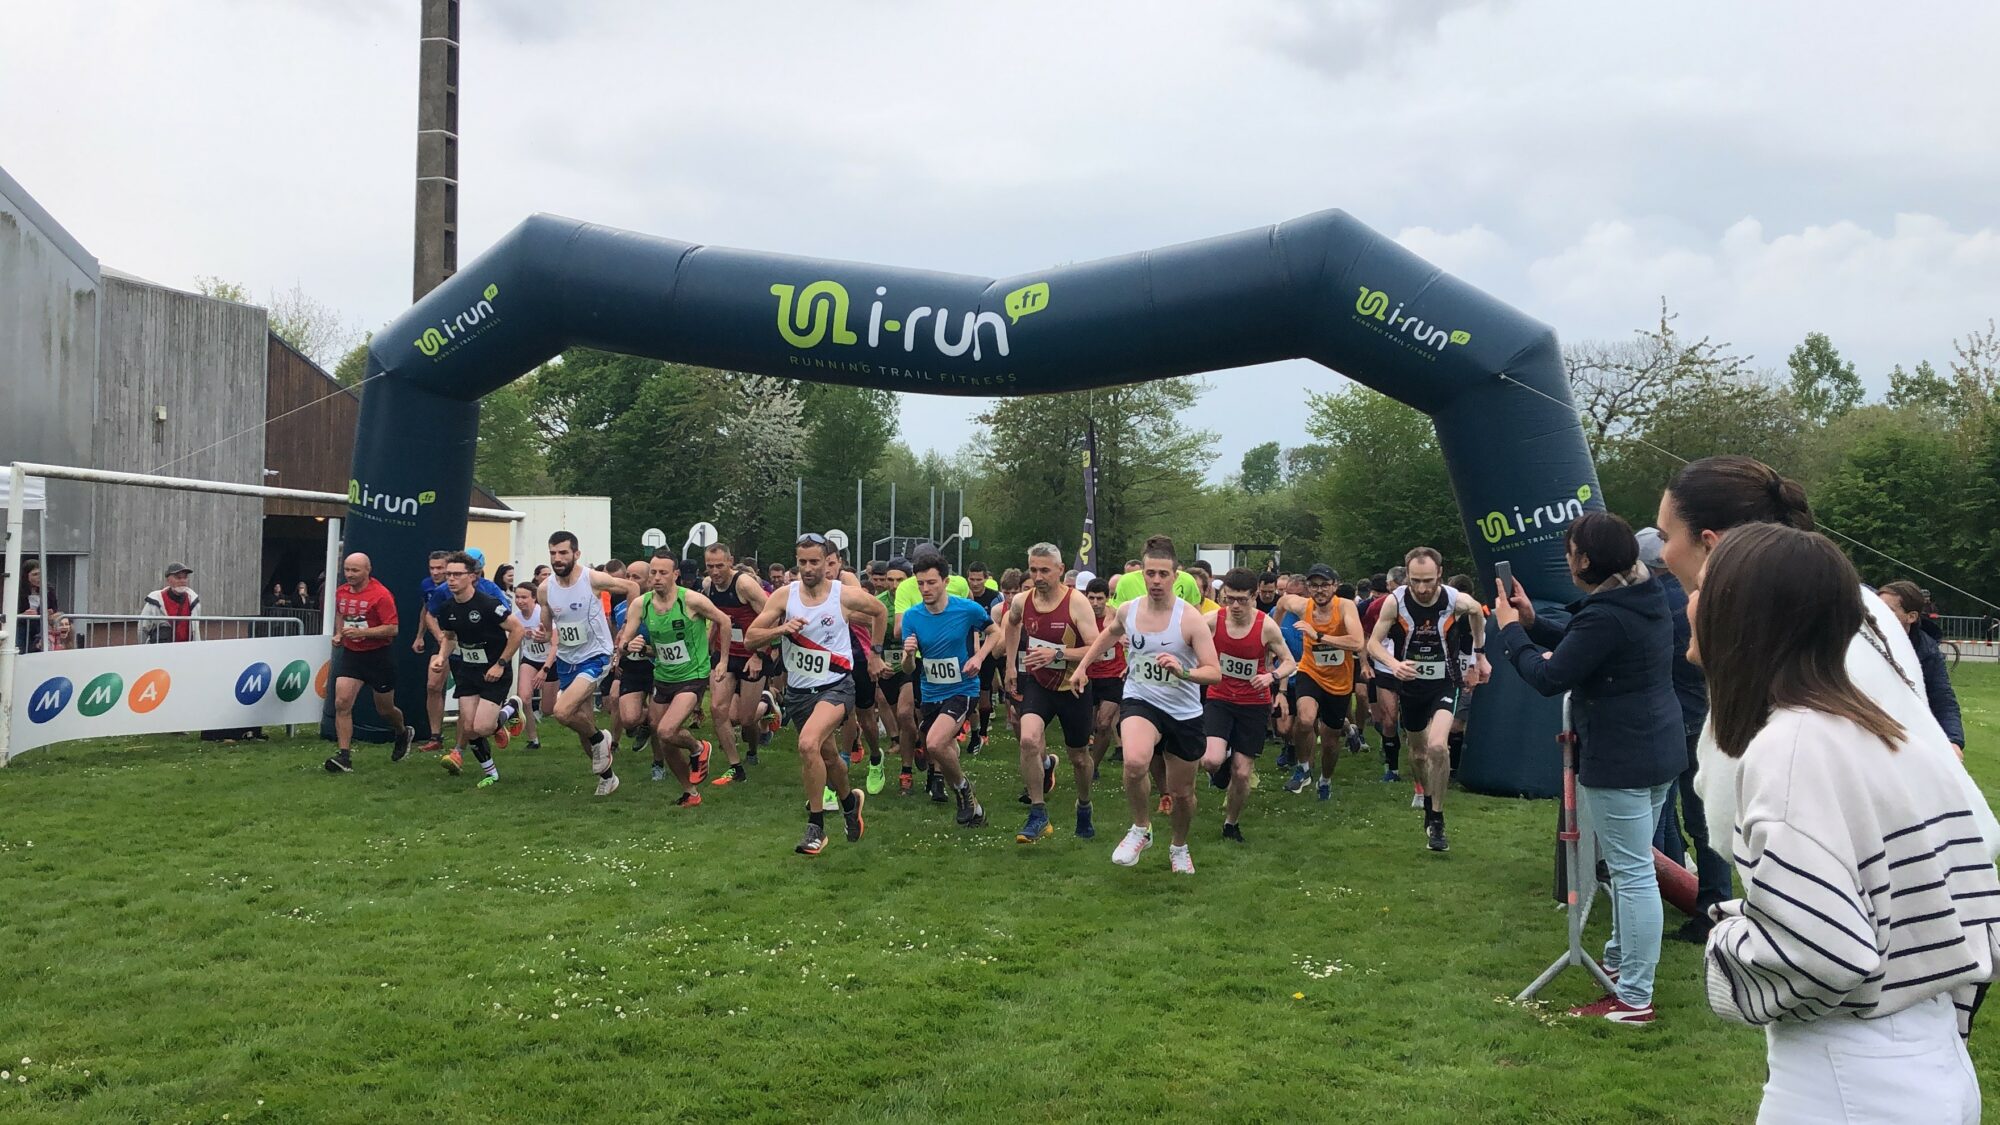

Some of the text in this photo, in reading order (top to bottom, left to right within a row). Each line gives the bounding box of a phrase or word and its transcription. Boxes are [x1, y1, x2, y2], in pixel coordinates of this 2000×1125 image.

[441, 300, 494, 339] i-run
[867, 286, 1010, 362] i-run
[1388, 302, 1449, 351] i-run
[789, 355, 1018, 386] RUNNING TRAIL FITNESS
[363, 483, 418, 516] i-run
[1513, 499, 1584, 533] i-run
[1527, 533, 1554, 545] TRAIL
[560, 626, 580, 642] 381
[467, 651, 480, 661] 18
[530, 643, 546, 655] 410
[662, 645, 684, 661] 382
[1321, 652, 1338, 663] 74
[796, 651, 824, 674] 399
[930, 662, 956, 679] 406
[1226, 659, 1253, 677] 396
[1415, 665, 1435, 676] 45
